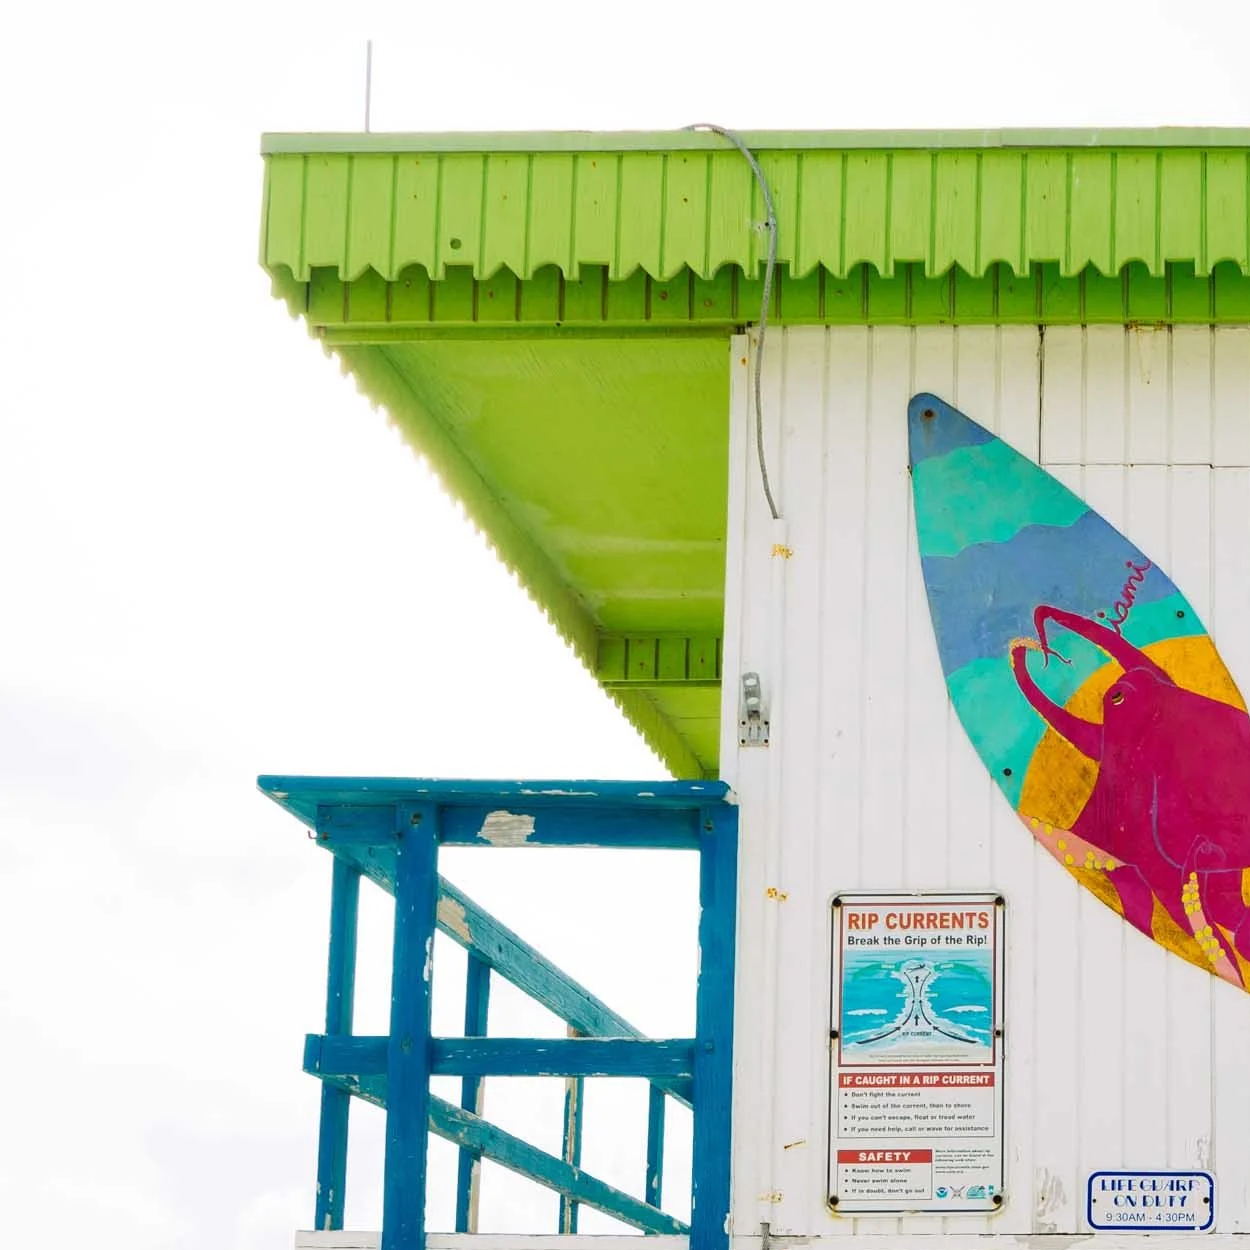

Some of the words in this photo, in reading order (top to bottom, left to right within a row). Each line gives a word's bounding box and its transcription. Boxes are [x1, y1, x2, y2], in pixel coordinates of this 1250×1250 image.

[848, 913, 879, 930] RIP
[885, 912, 989, 930] CURRENTS
[848, 936, 879, 945] Break
[884, 936, 900, 945] the
[905, 935, 926, 947] Grip
[931, 935, 942, 945] of
[946, 935, 962, 944] the
[966, 935, 987, 946] Rip!
[856, 1076, 896, 1084] CAUGHT
[900, 1076, 911, 1084] IN
[913, 1076, 920, 1084] A
[923, 1076, 939, 1084] RIP
[942, 1075, 989, 1084] CURRENT
[859, 1152, 911, 1161] SAFETY
[1114, 1195, 1137, 1207] ON
[1143, 1195, 1187, 1207] DUTY
